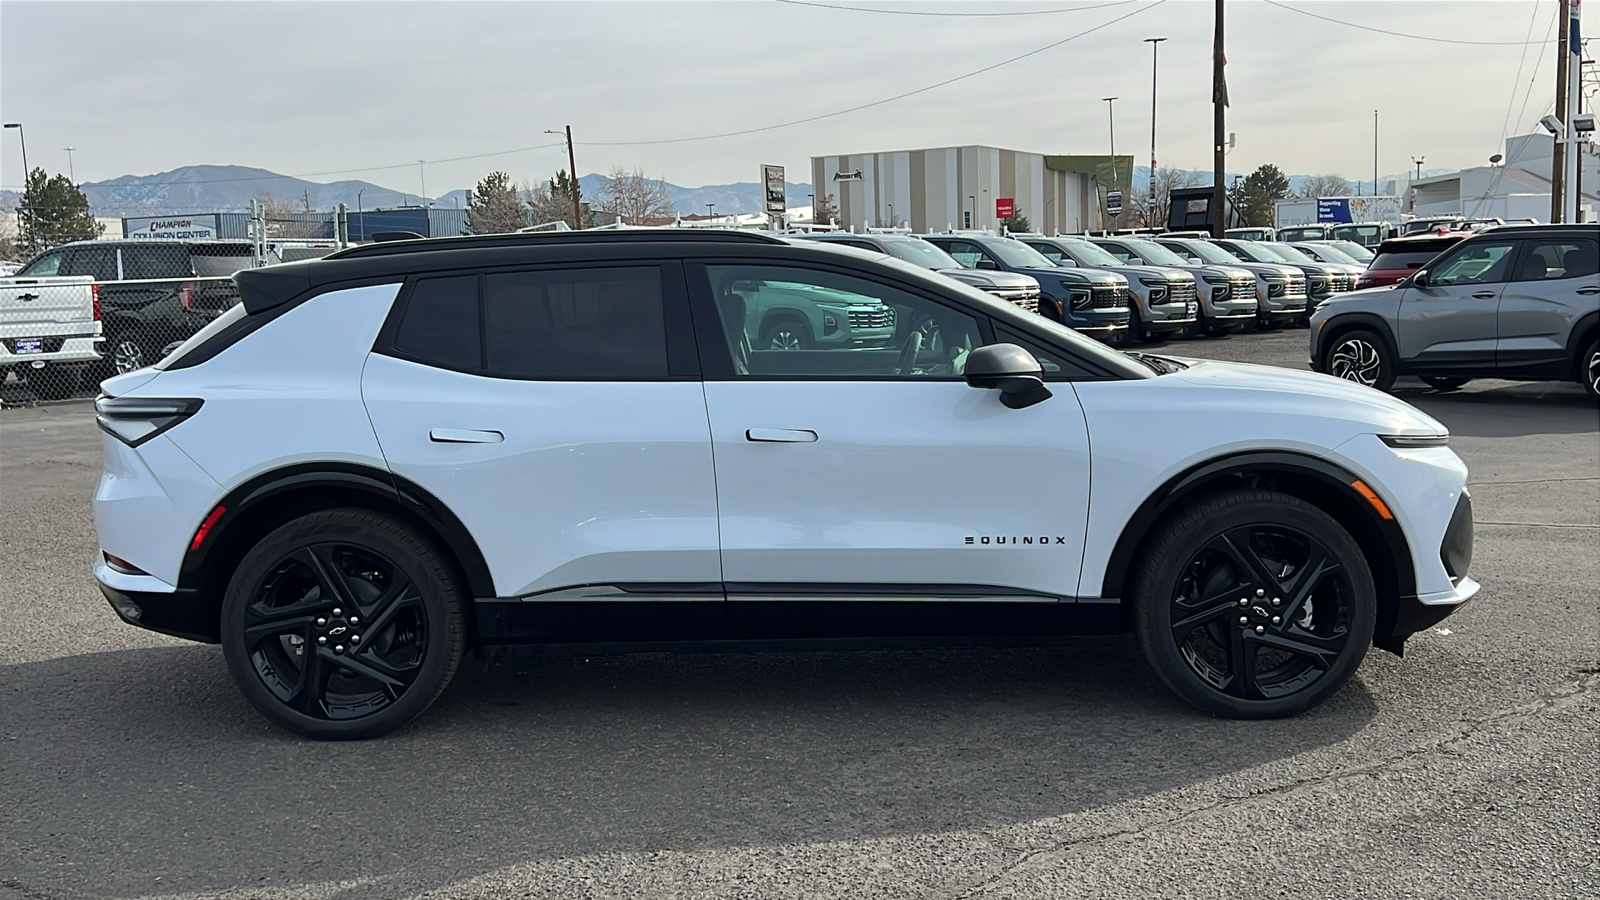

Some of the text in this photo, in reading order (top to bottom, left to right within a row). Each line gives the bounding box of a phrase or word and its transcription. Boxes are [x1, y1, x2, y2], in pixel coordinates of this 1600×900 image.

[150, 220, 192, 231] CHAMPION
[176, 230, 211, 239] CENTER
[964, 536, 1066, 545] EQUINOX
